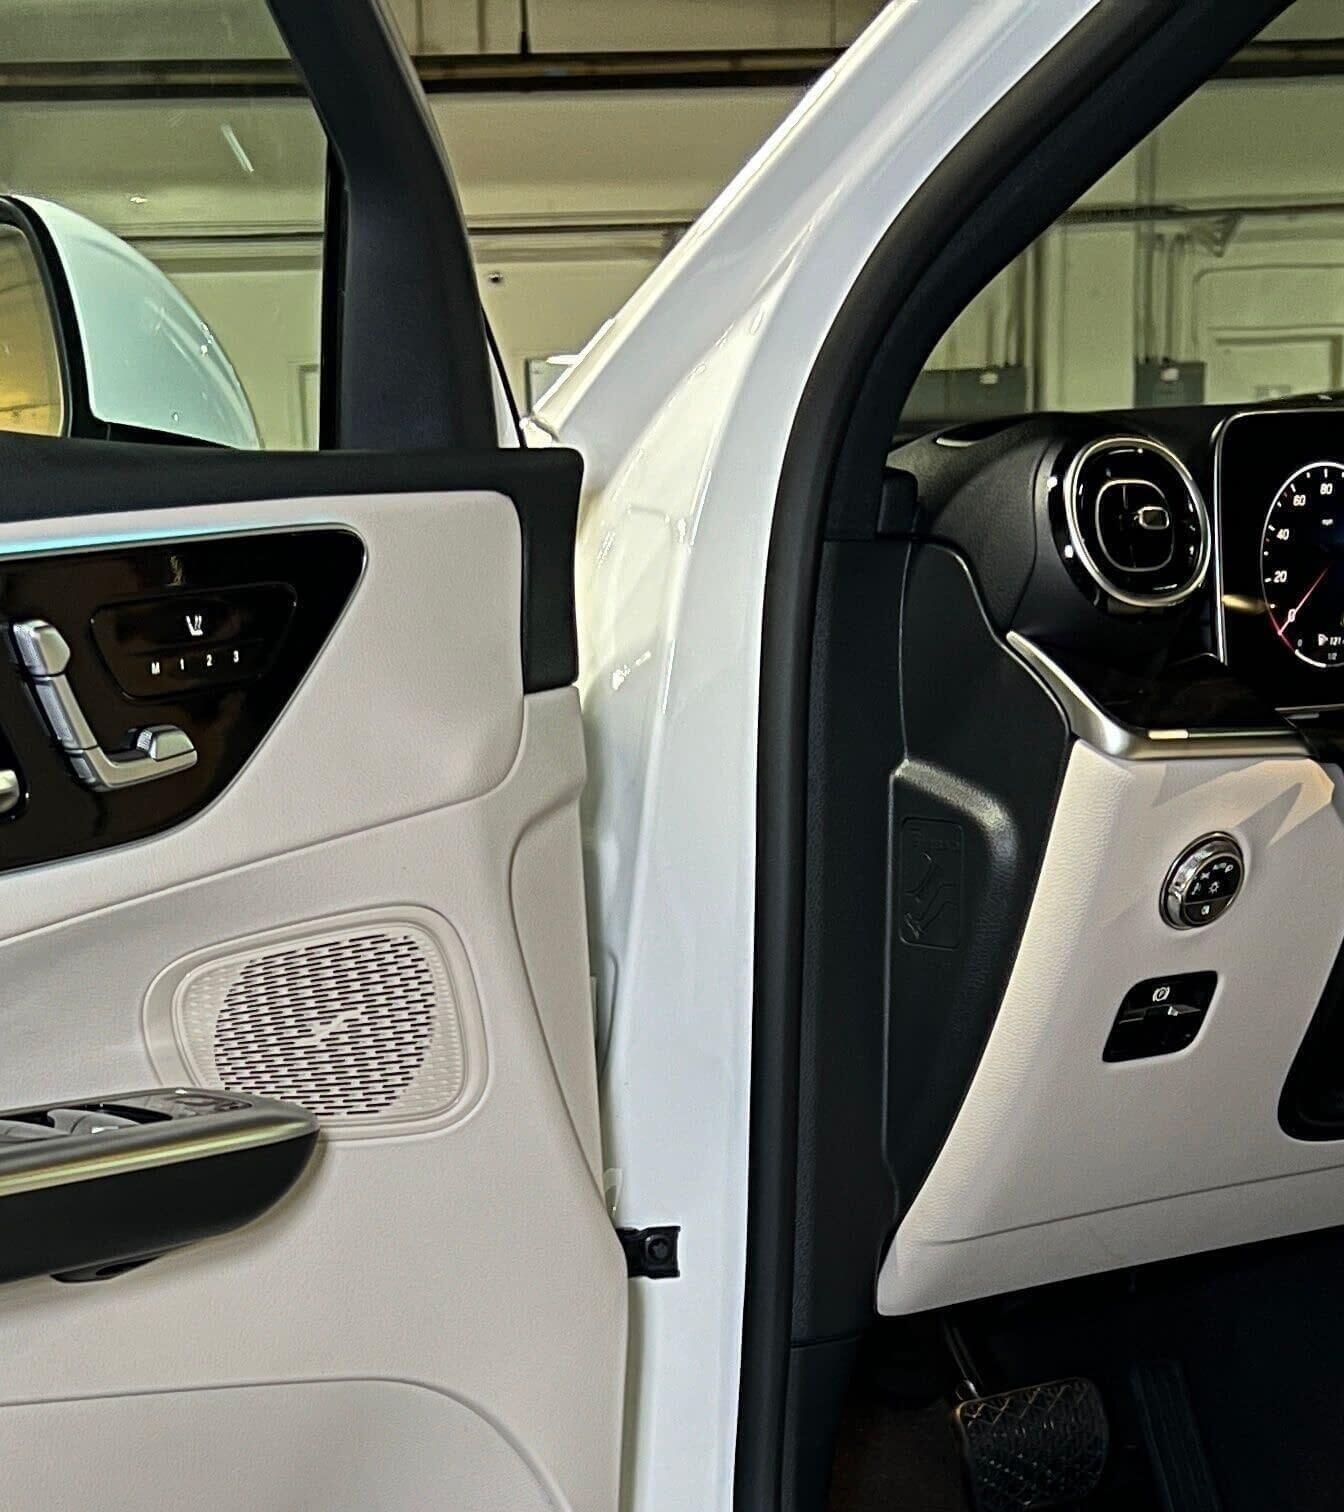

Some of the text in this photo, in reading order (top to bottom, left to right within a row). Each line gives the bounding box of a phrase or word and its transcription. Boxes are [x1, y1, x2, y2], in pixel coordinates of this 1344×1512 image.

[1320, 483, 1333, 495] 80
[1293, 495, 1306, 507] 60
[1276, 528, 1289, 540] 40
[1273, 570, 1287, 583] 20
[151, 650, 239, 675] M 1 2 3
